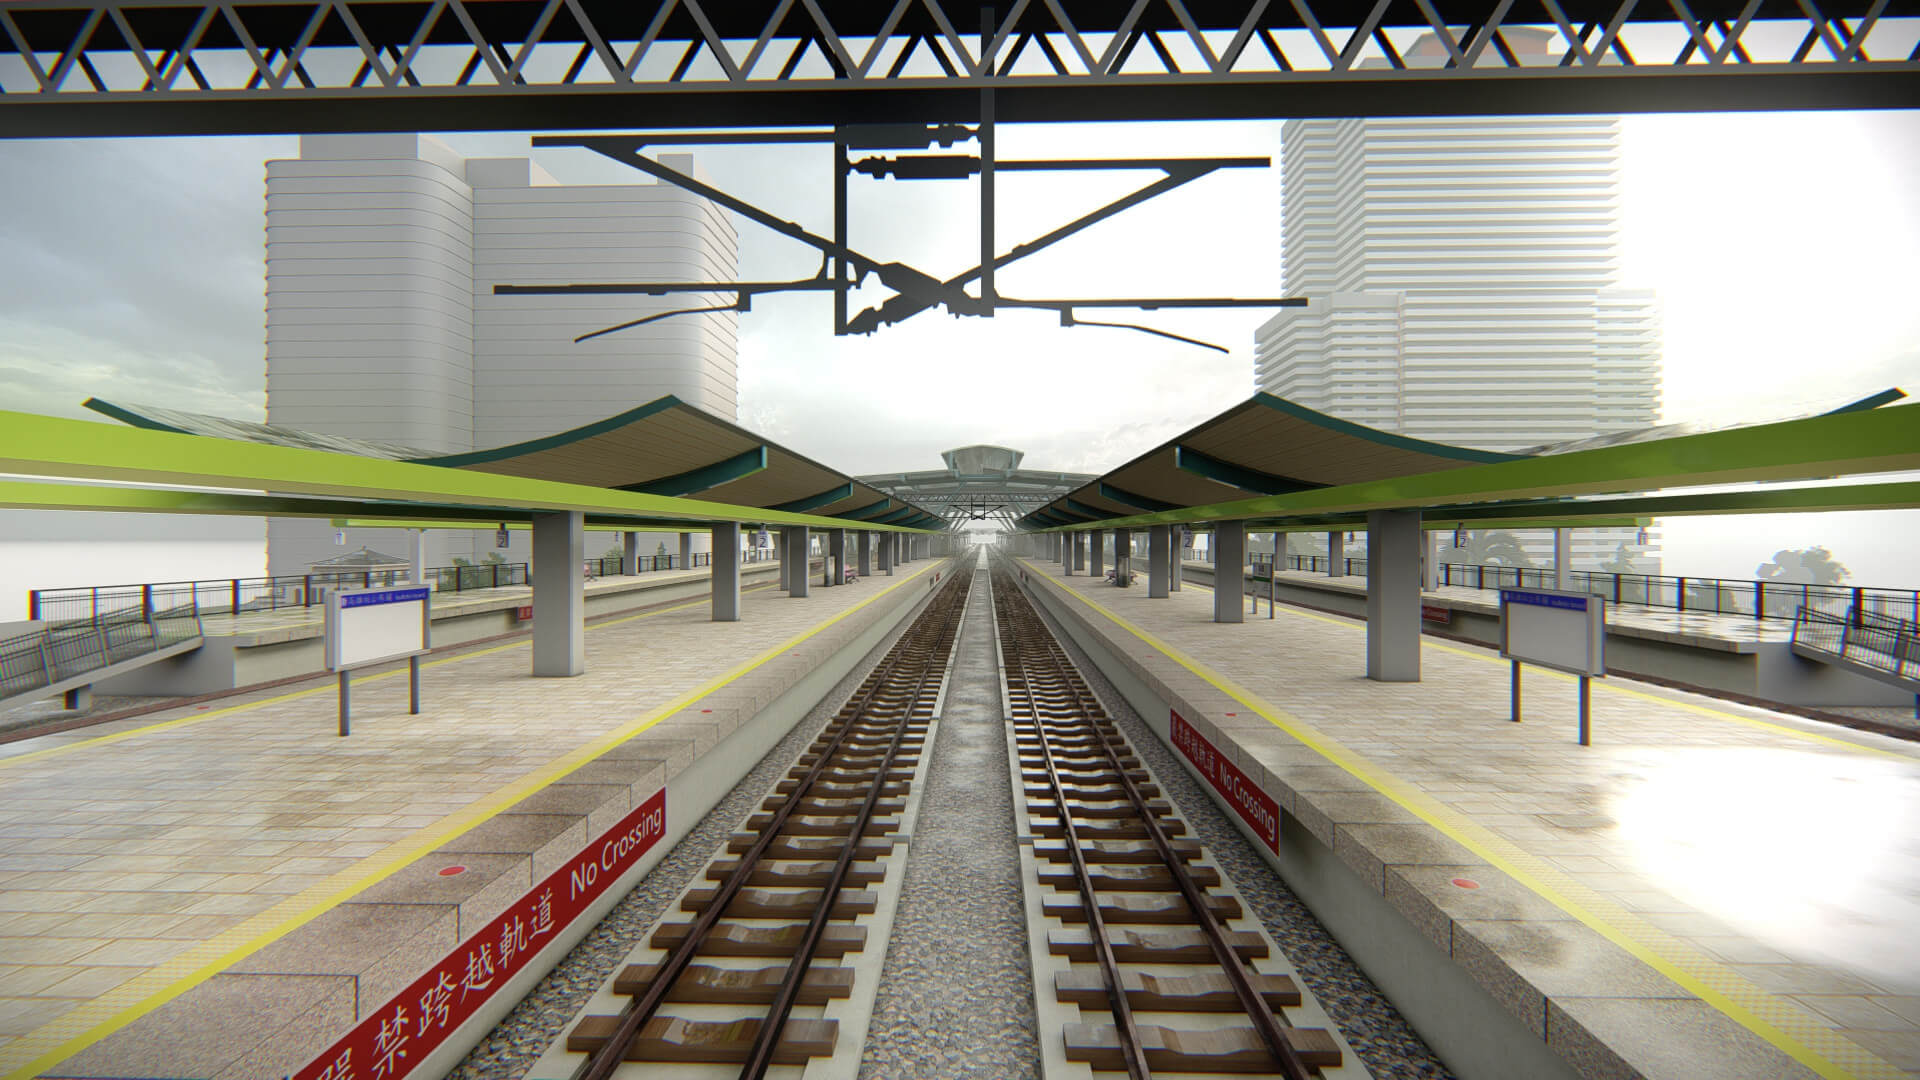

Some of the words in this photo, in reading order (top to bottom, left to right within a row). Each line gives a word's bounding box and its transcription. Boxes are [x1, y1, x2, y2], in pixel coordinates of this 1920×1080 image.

[1219, 762, 1233, 791] No
[1233, 776, 1276, 842] Crossing
[570, 863, 598, 902] No
[601, 806, 662, 873] Crossing
